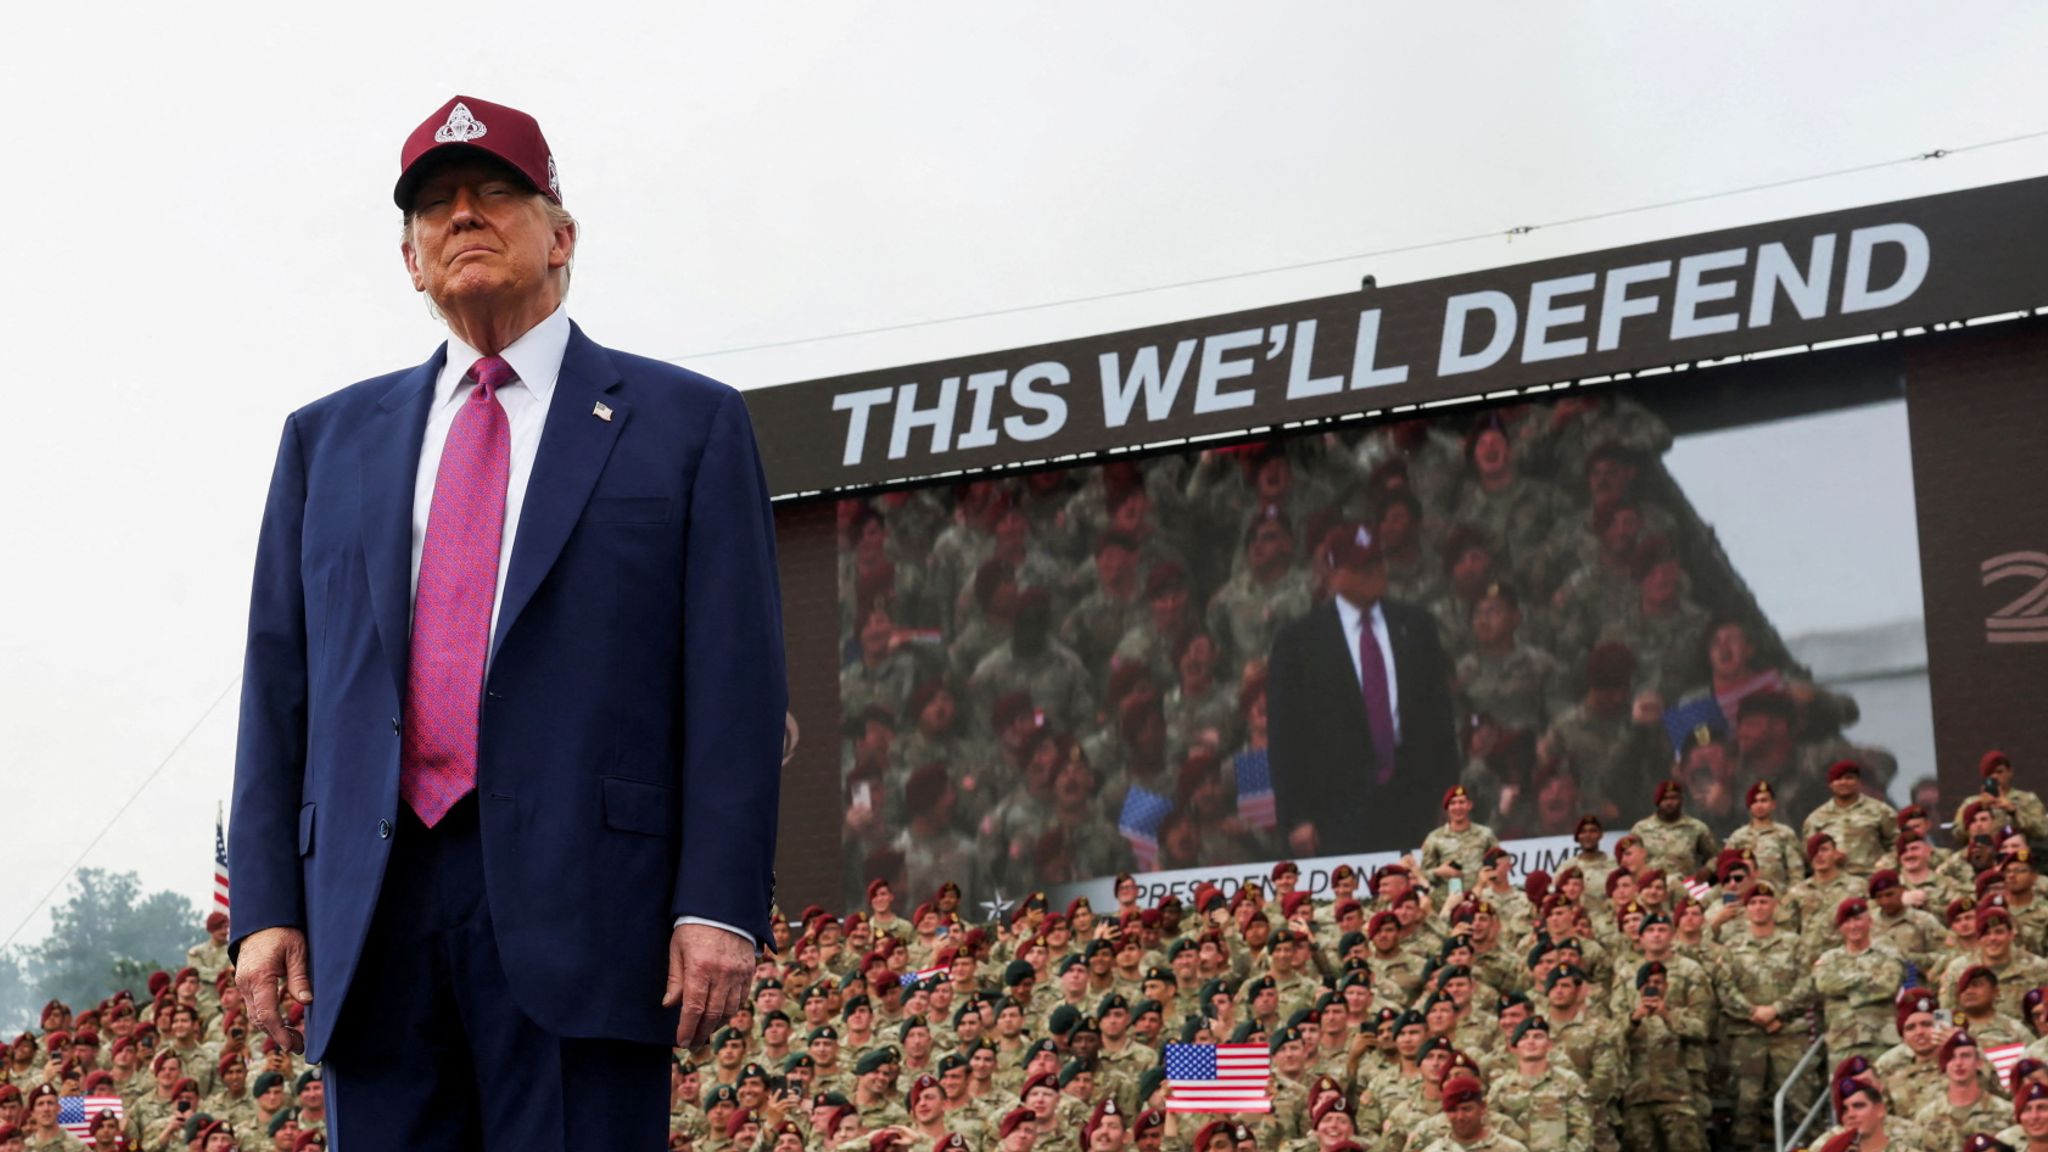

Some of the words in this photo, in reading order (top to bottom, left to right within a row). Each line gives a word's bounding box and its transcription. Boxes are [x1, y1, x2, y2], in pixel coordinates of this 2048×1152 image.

[832, 361, 1071, 467] THIS
[1099, 308, 1409, 428] WE'LL
[1437, 222, 1931, 377] DEFEND
[1136, 871, 1302, 907] PRESDN
[1507, 846, 1582, 876] RUM
